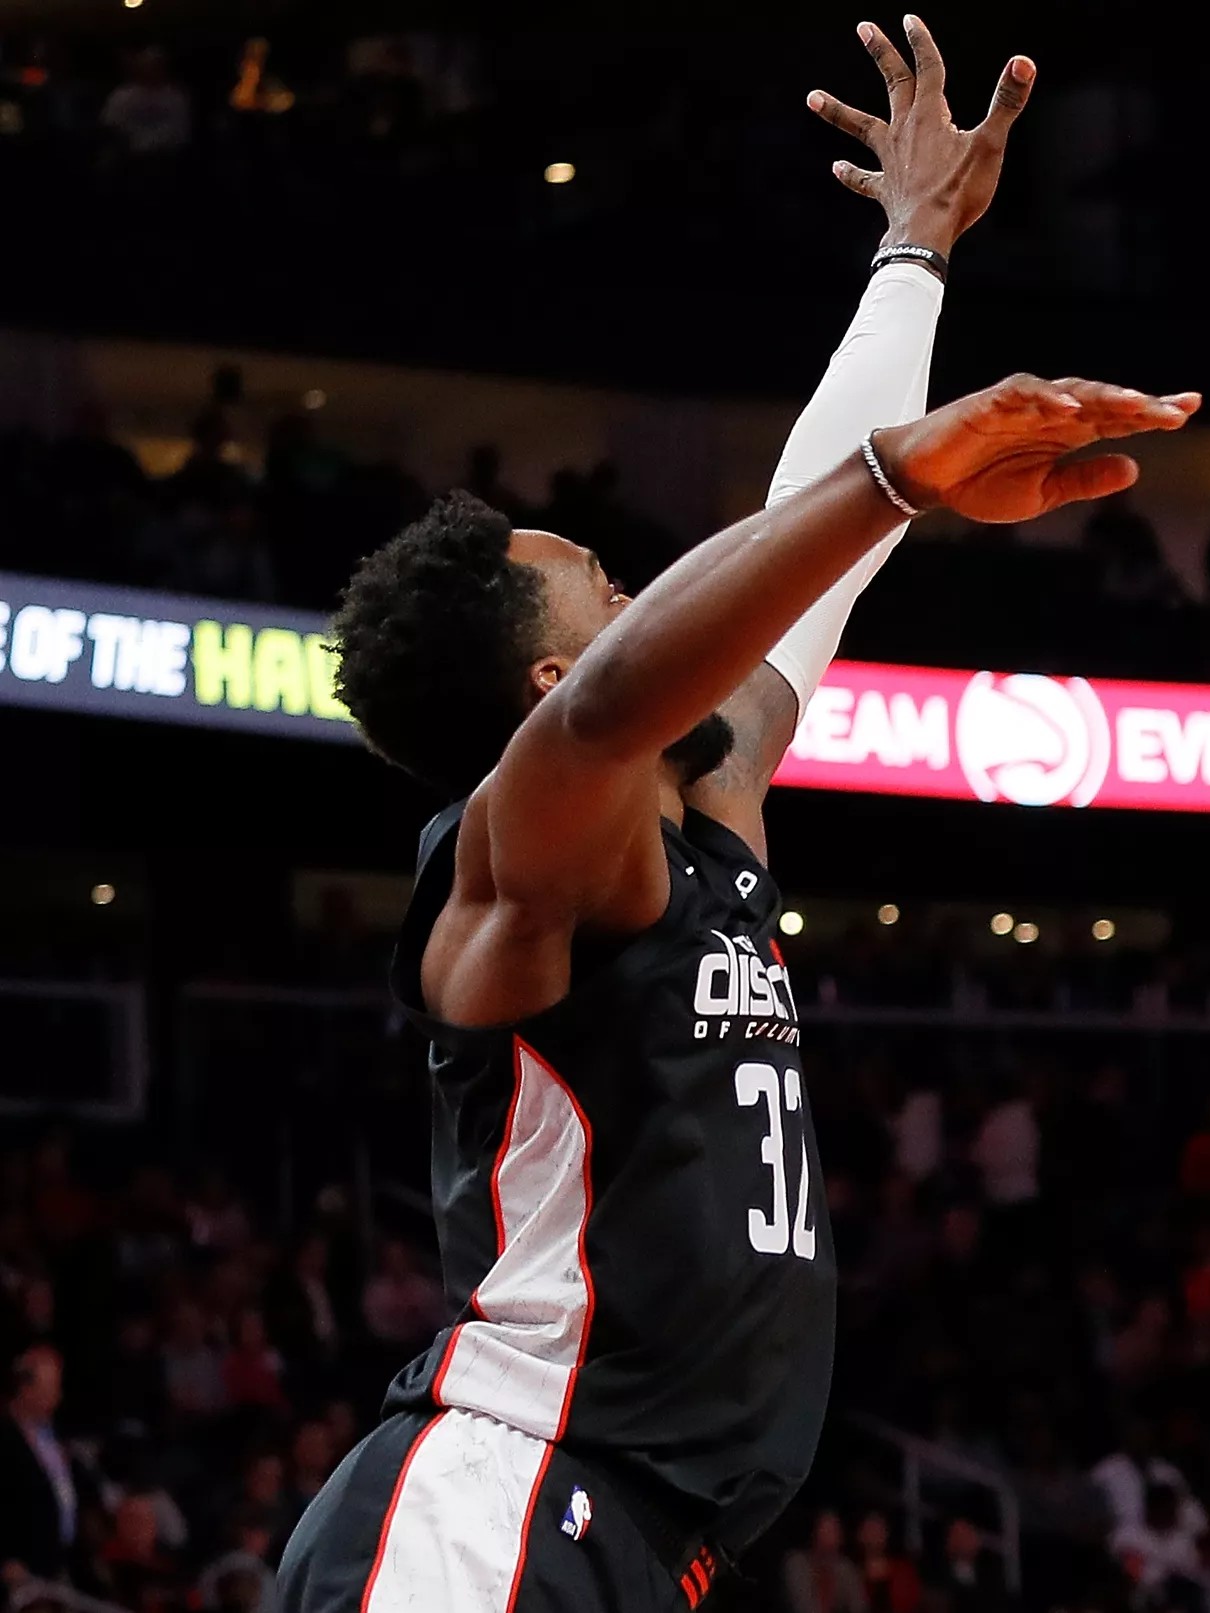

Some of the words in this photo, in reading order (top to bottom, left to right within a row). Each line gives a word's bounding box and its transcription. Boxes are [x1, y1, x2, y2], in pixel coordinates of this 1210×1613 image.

[9, 603, 87, 684] OF
[87, 612, 191, 697] THE
[734, 1062, 816, 1262] 32
